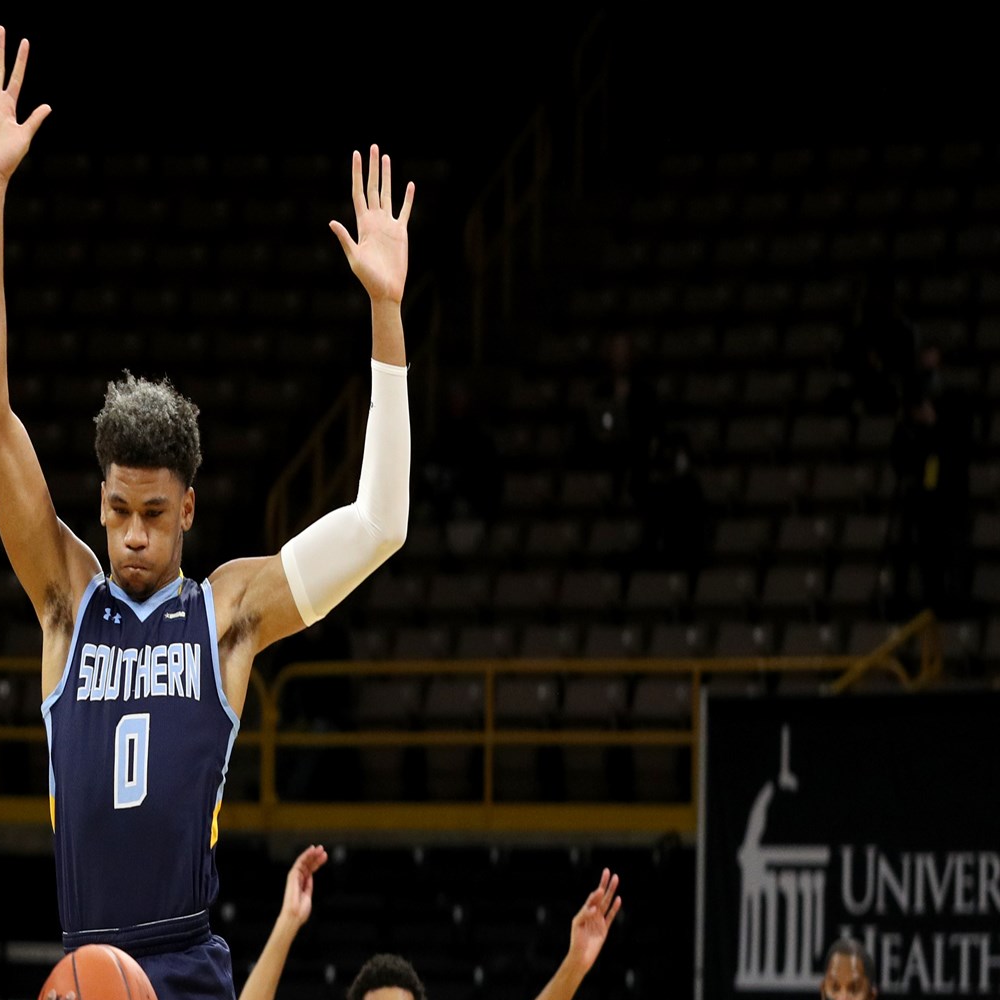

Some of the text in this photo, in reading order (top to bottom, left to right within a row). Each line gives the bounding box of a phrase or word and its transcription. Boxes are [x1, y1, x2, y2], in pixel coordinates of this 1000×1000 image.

[77, 643, 201, 702] SOUTHERN
[114, 713, 150, 809] 0
[839, 843, 1000, 916] UNIVER
